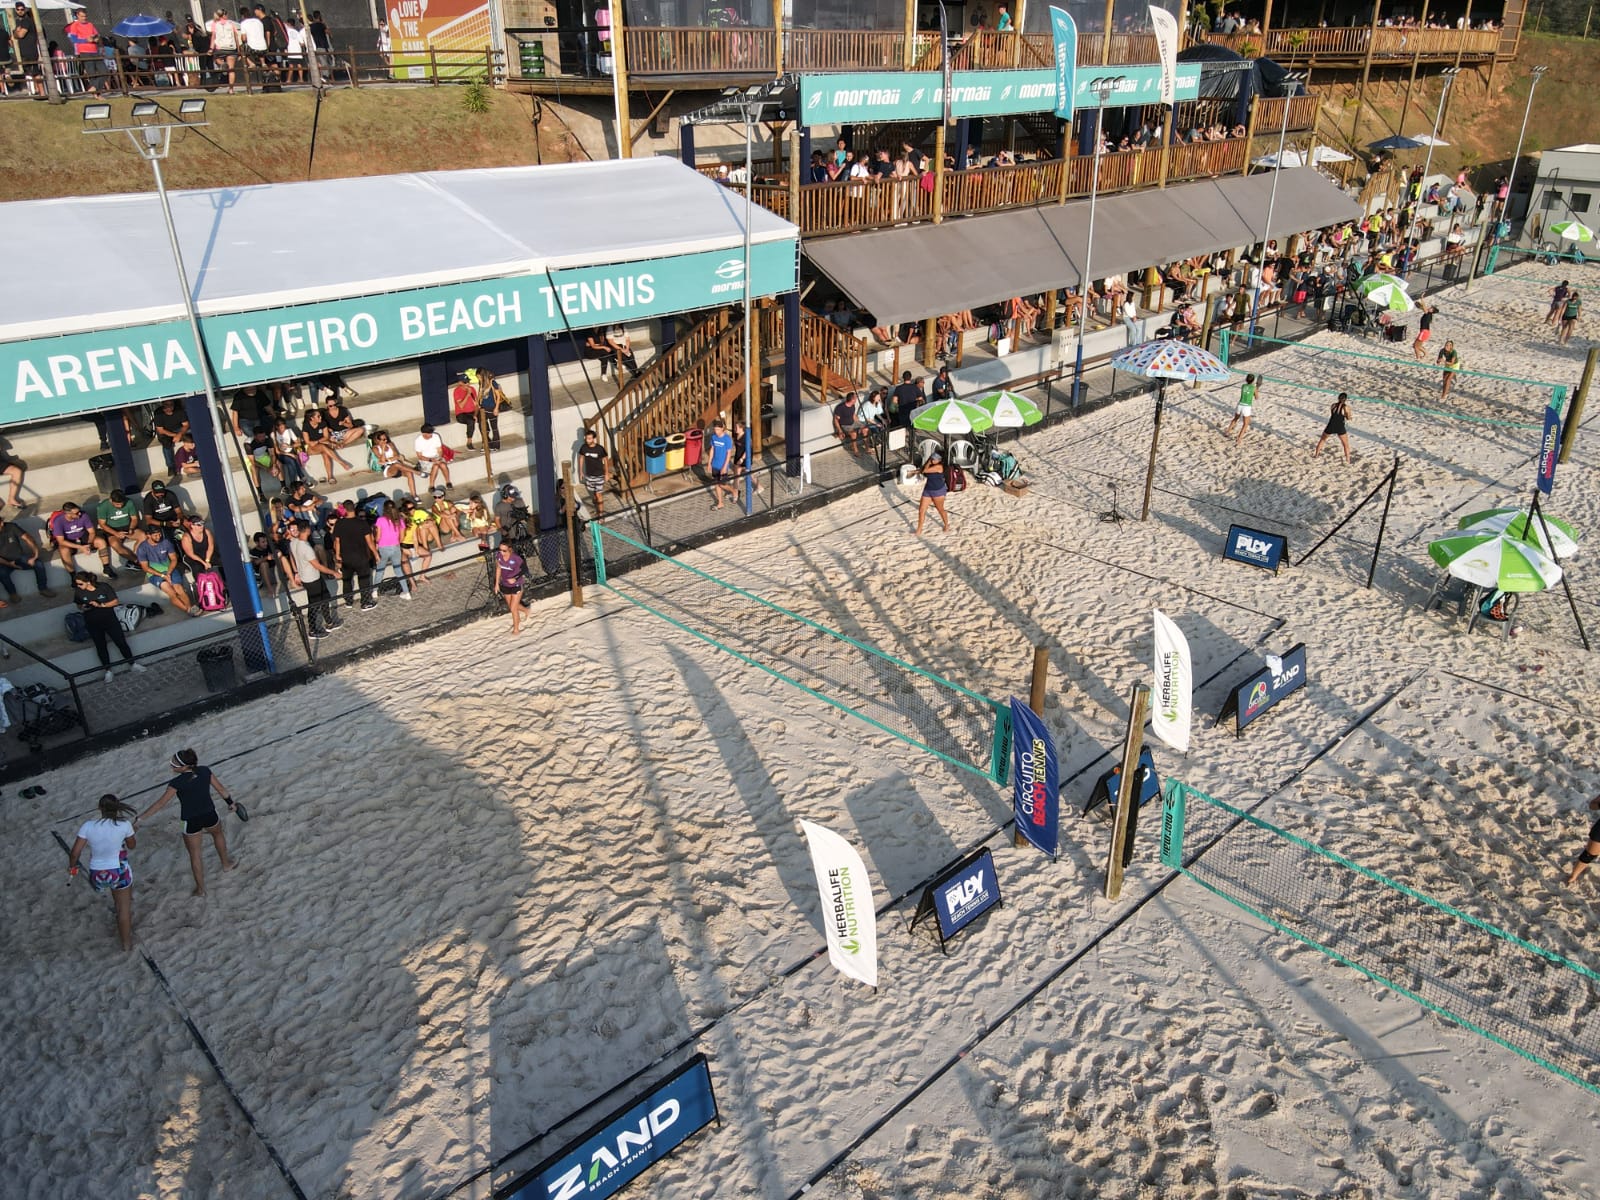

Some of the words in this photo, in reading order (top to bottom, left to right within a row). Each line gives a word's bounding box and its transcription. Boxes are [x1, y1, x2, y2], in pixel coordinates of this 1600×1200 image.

[398, 0, 419, 17] LOVE
[403, 20, 419, 37] THE
[402, 40, 425, 56] GAME
[833, 89, 901, 107] mormaii
[15, 339, 196, 402] ARENA
[222, 312, 378, 370] AVEIRO
[400, 291, 522, 341] BEACH
[539, 274, 655, 318] TENNIS
[1162, 652, 1172, 707] HERBALIFE
[1171, 651, 1180, 709] NUTRITION
[1022, 752, 1034, 815] CIRCUITO
[1033, 738, 1047, 784] TENNIS
[1032, 781, 1047, 827] BEACH
[828, 868, 847, 938] HERBALIFE
[840, 867, 860, 936] NUTRITION
[548, 1098, 681, 1200] ZAND
[588, 1168, 620, 1192] BEACH
[620, 1142, 653, 1169] TENNIS
